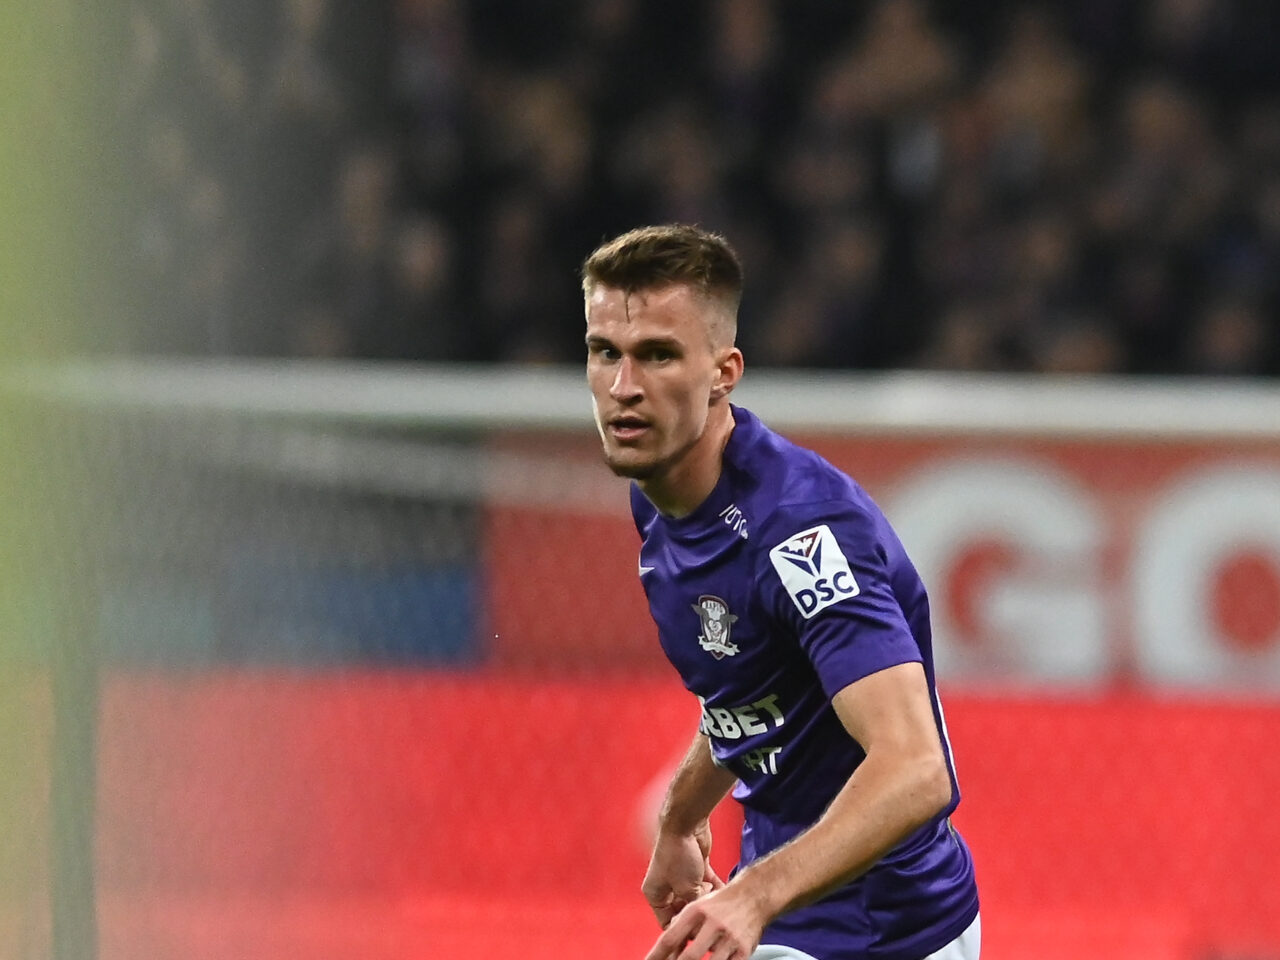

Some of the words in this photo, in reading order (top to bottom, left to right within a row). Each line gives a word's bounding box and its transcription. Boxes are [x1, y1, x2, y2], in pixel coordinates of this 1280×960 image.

[794, 571, 855, 614] DSC
[698, 694, 785, 739] RBET
[743, 746, 783, 775] RT
